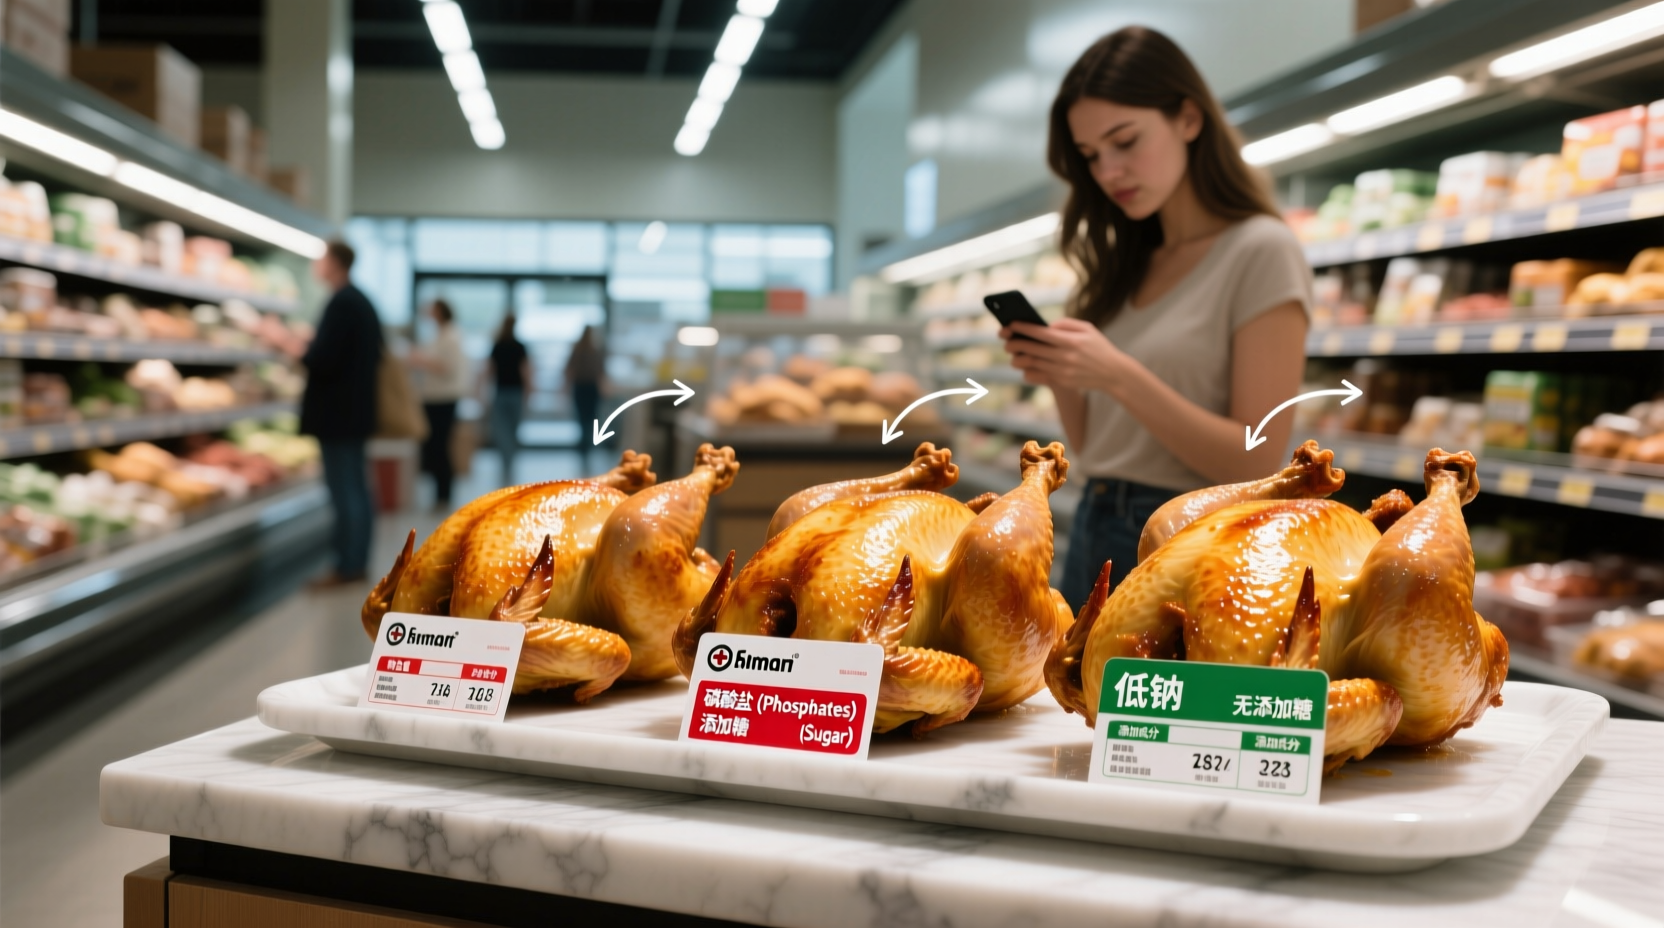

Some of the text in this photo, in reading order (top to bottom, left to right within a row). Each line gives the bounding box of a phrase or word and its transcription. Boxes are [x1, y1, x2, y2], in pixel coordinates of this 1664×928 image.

[757, 693, 857, 722] (Phosphates)
[1114, 672, 1184, 711] 低钠
[1232, 694, 1313, 721] 无添加糖
[699, 713, 854, 749] 添加糖 (Sugar)
